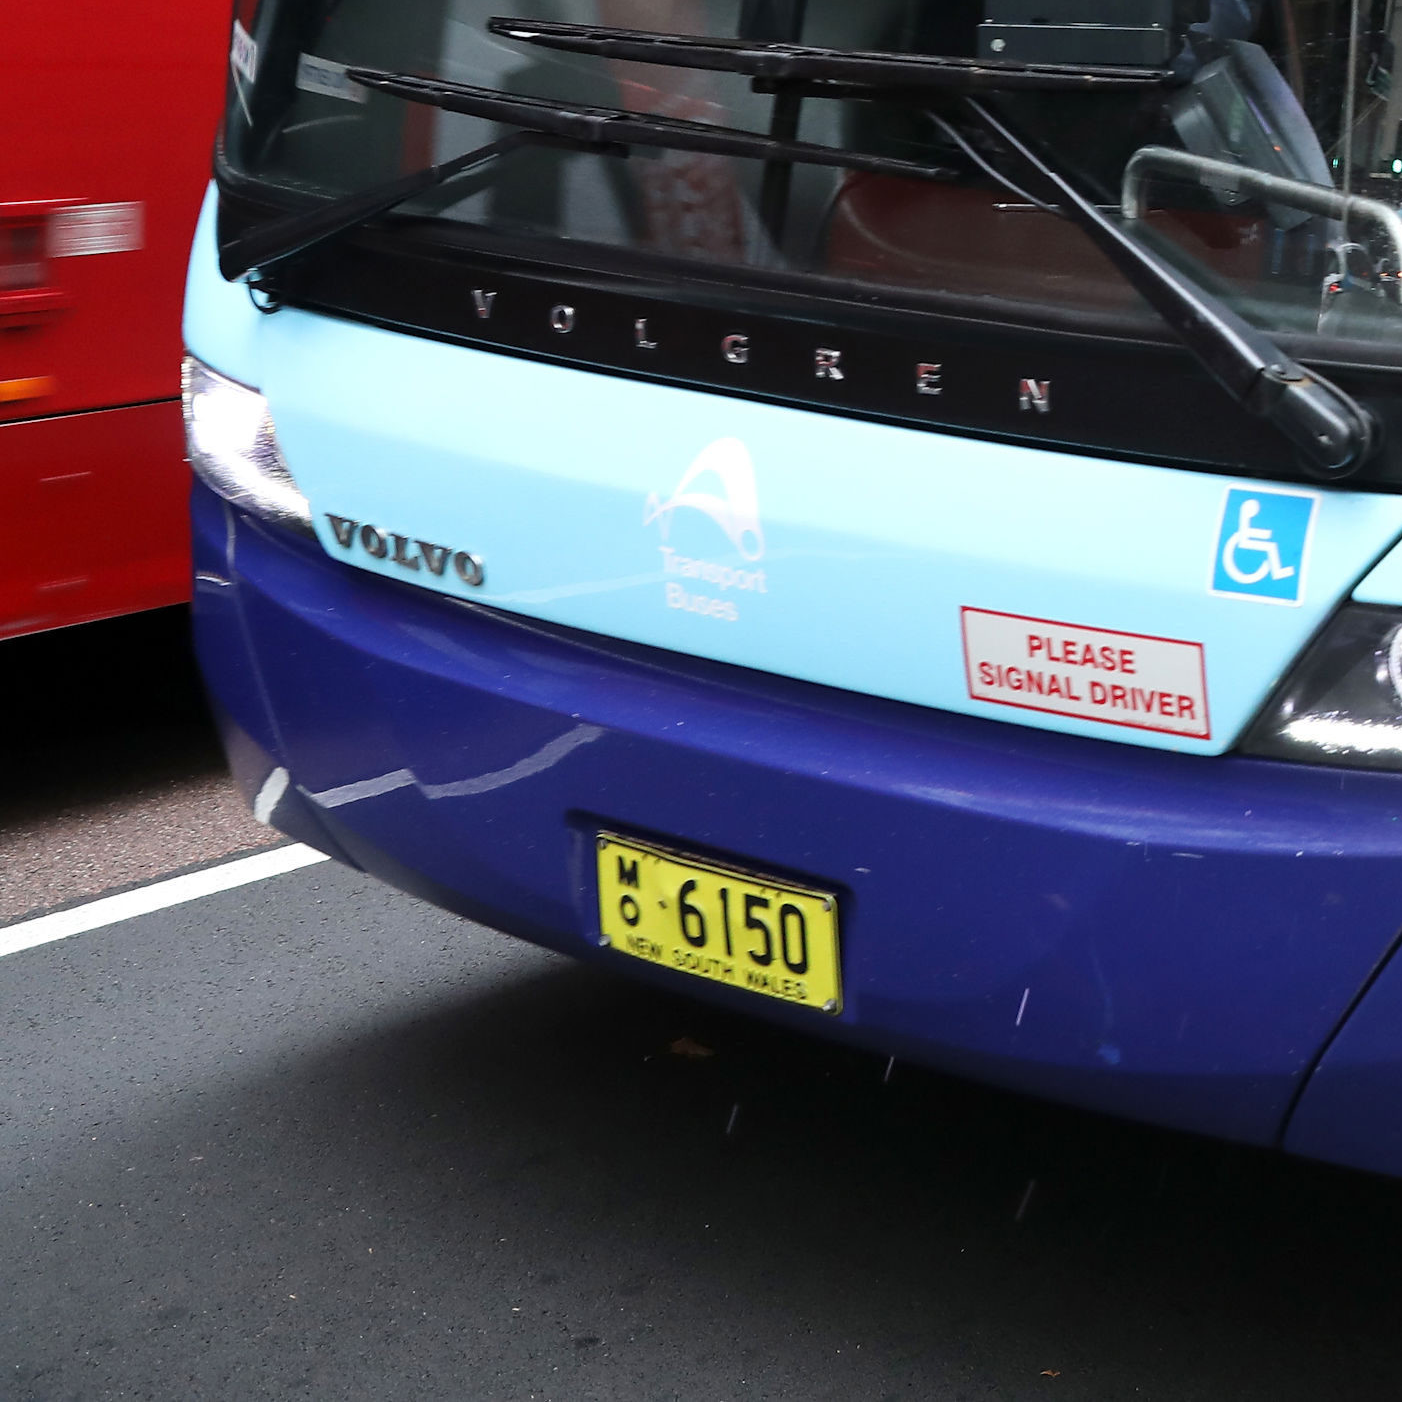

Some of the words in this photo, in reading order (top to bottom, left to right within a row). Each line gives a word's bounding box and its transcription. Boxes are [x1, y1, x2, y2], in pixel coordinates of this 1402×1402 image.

[471, 289, 1051, 414] VOLGREN
[324, 512, 485, 588] VOLVO
[659, 545, 768, 594] Transport
[665, 581, 739, 622] Buses
[1027, 633, 1136, 675] PLEASE
[976, 661, 1082, 701] SIGNAL
[1088, 681, 1196, 720] DRIVER
[678, 879, 809, 975] 6150
[626, 933, 663, 959] NEW
[672, 949, 736, 981] SOUTH
[745, 967, 808, 1000] WALES
